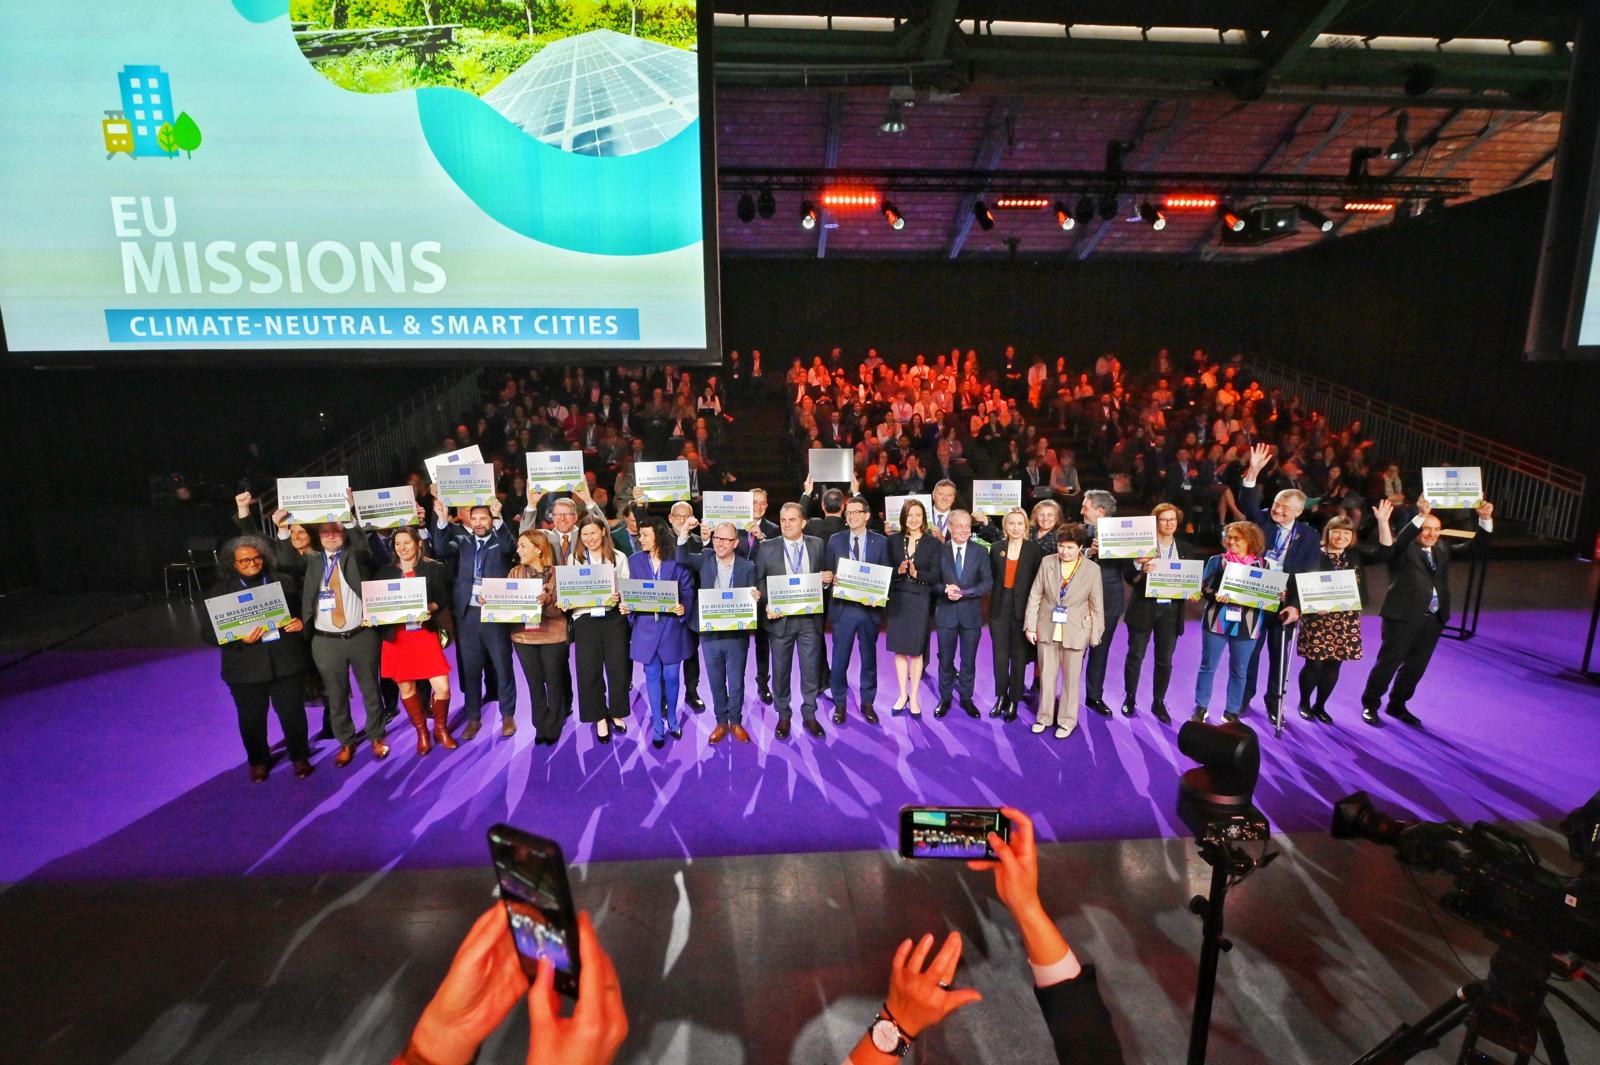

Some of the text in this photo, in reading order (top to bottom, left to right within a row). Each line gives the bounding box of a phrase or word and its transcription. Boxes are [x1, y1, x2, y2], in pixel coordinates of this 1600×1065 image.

[110, 196, 178, 237] EU
[121, 240, 447, 294] MISSIONS
[129, 315, 620, 338] CLIMATE-NEUTRAL & SMART CITIES
[368, 502, 394, 510] MISSION
[395, 499, 413, 507] LABEL
[1235, 578, 1261, 587] MISSION
[1261, 582, 1280, 592] LABEL
[226, 605, 259, 617] MISSION
[259, 598, 283, 609] LABEL
